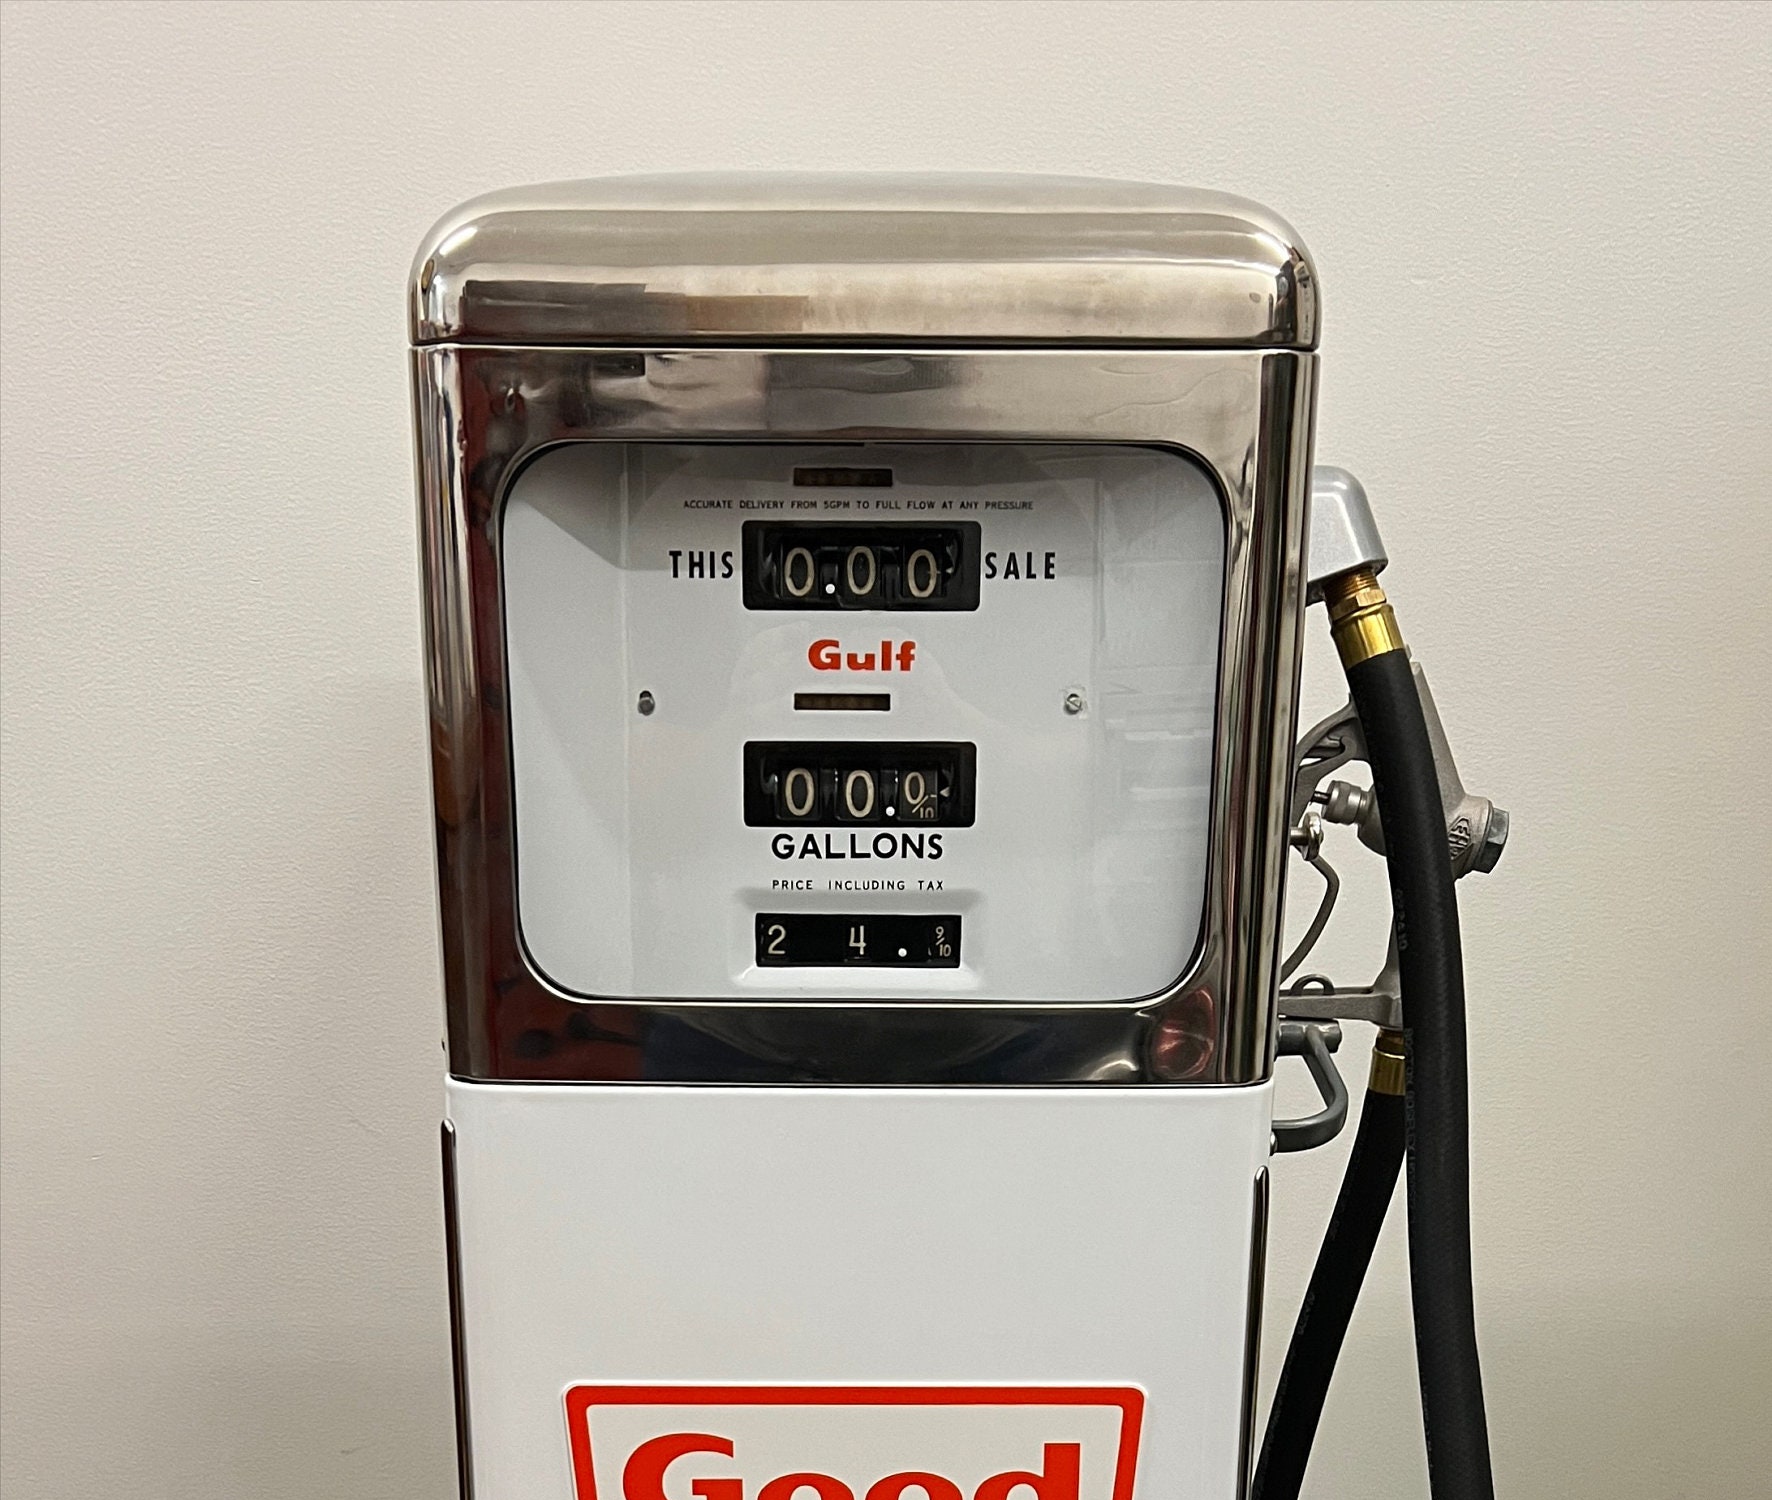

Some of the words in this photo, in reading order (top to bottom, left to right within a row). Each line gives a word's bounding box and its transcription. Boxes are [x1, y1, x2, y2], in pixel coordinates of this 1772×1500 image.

[683, 500, 732, 510] ACCURATE
[739, 500, 785, 510] DELIVERY
[791, 500, 817, 510] FROM
[824, 500, 850, 510] 5GPM
[856, 500, 870, 510] TO
[876, 500, 901, 510] FULL
[907, 500, 936, 510] FLOW
[941, 500, 953, 510] AT
[959, 500, 979, 510] ANY
[985, 500, 1034, 510] PRESSURE
[669, 550, 734, 579] THIS
[984, 551, 1056, 580] SALE
[807, 639, 916, 672] Gulf
[771, 833, 943, 860] GALLONS
[772, 880, 813, 890] PRICE
[828, 880, 905, 890] INCLUDING
[917, 880, 944, 891] TAX
